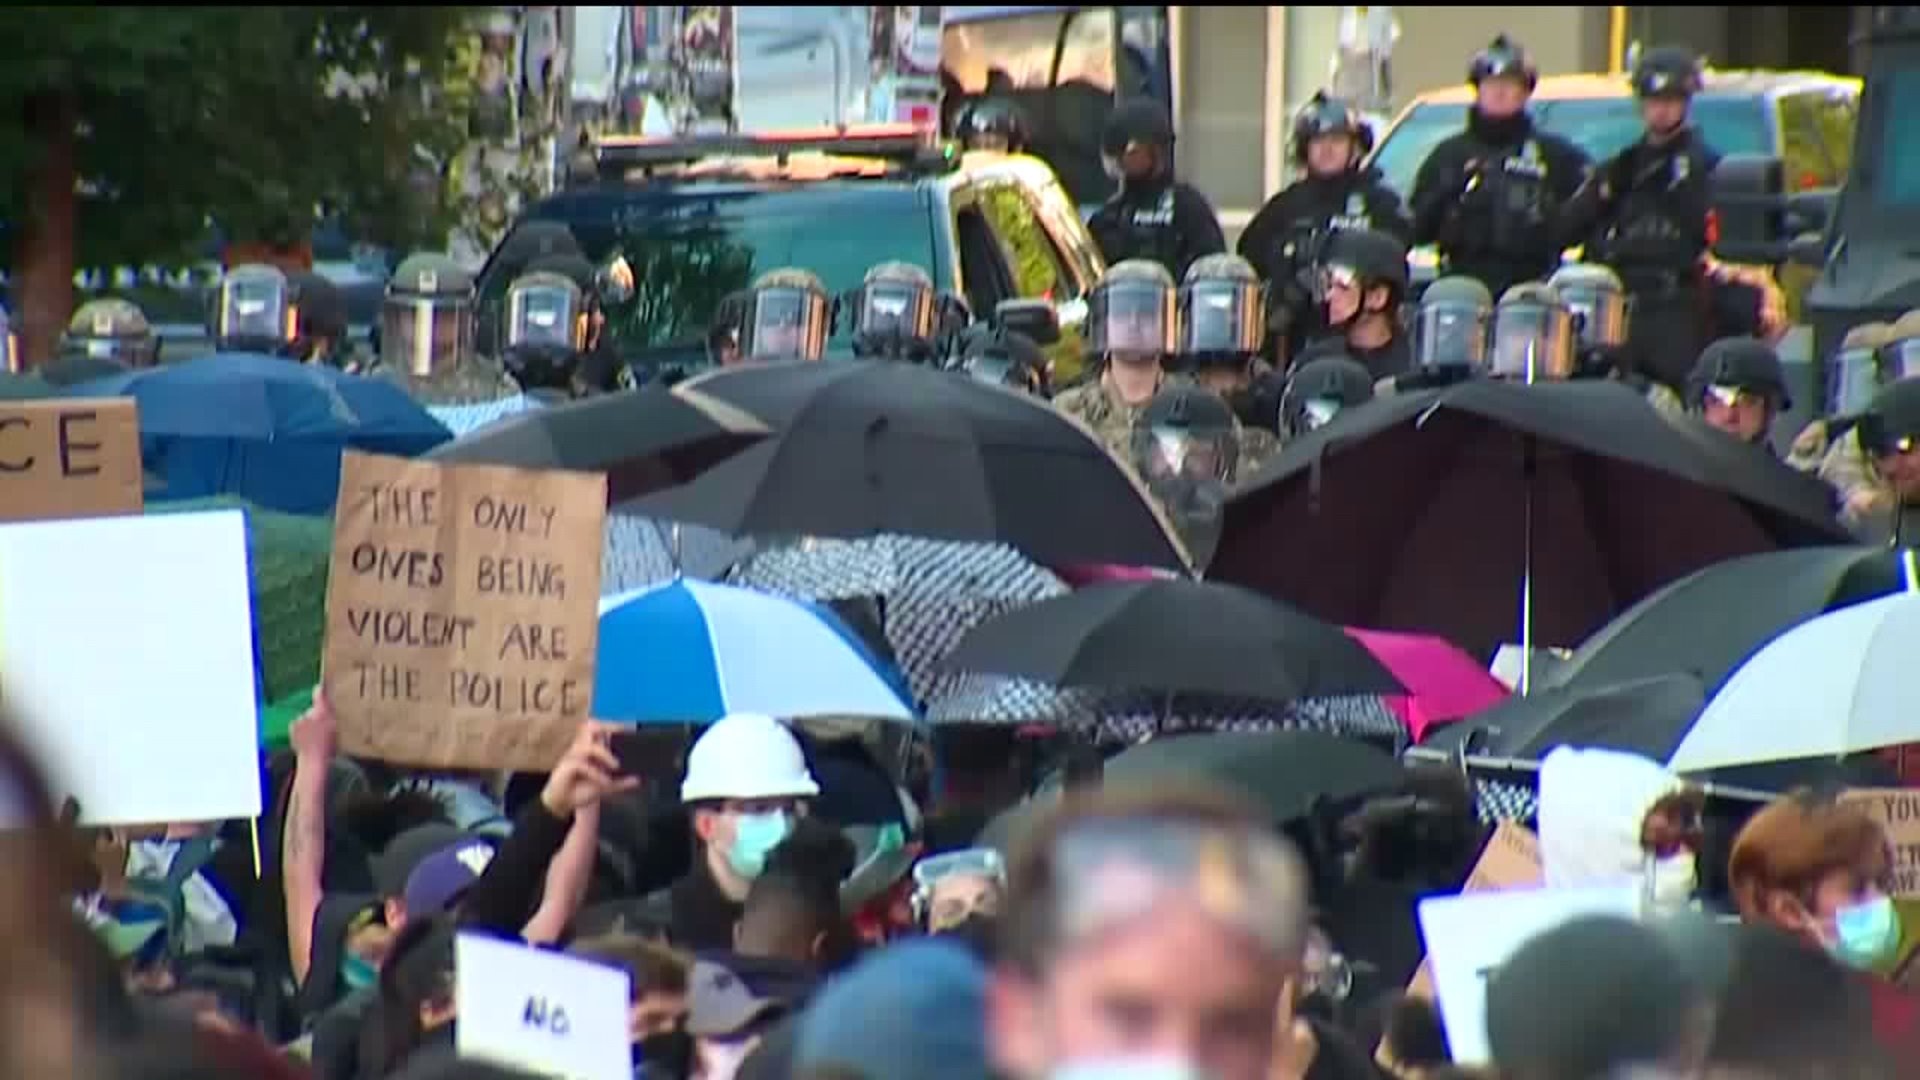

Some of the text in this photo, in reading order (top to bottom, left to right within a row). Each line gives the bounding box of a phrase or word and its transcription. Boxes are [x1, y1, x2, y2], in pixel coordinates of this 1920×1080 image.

[363, 484, 556, 538] THE ONLY
[352, 542, 566, 600] ONES BEING
[347, 607, 568, 661] VIOLENT ARE
[352, 659, 577, 715] THE POLICE
